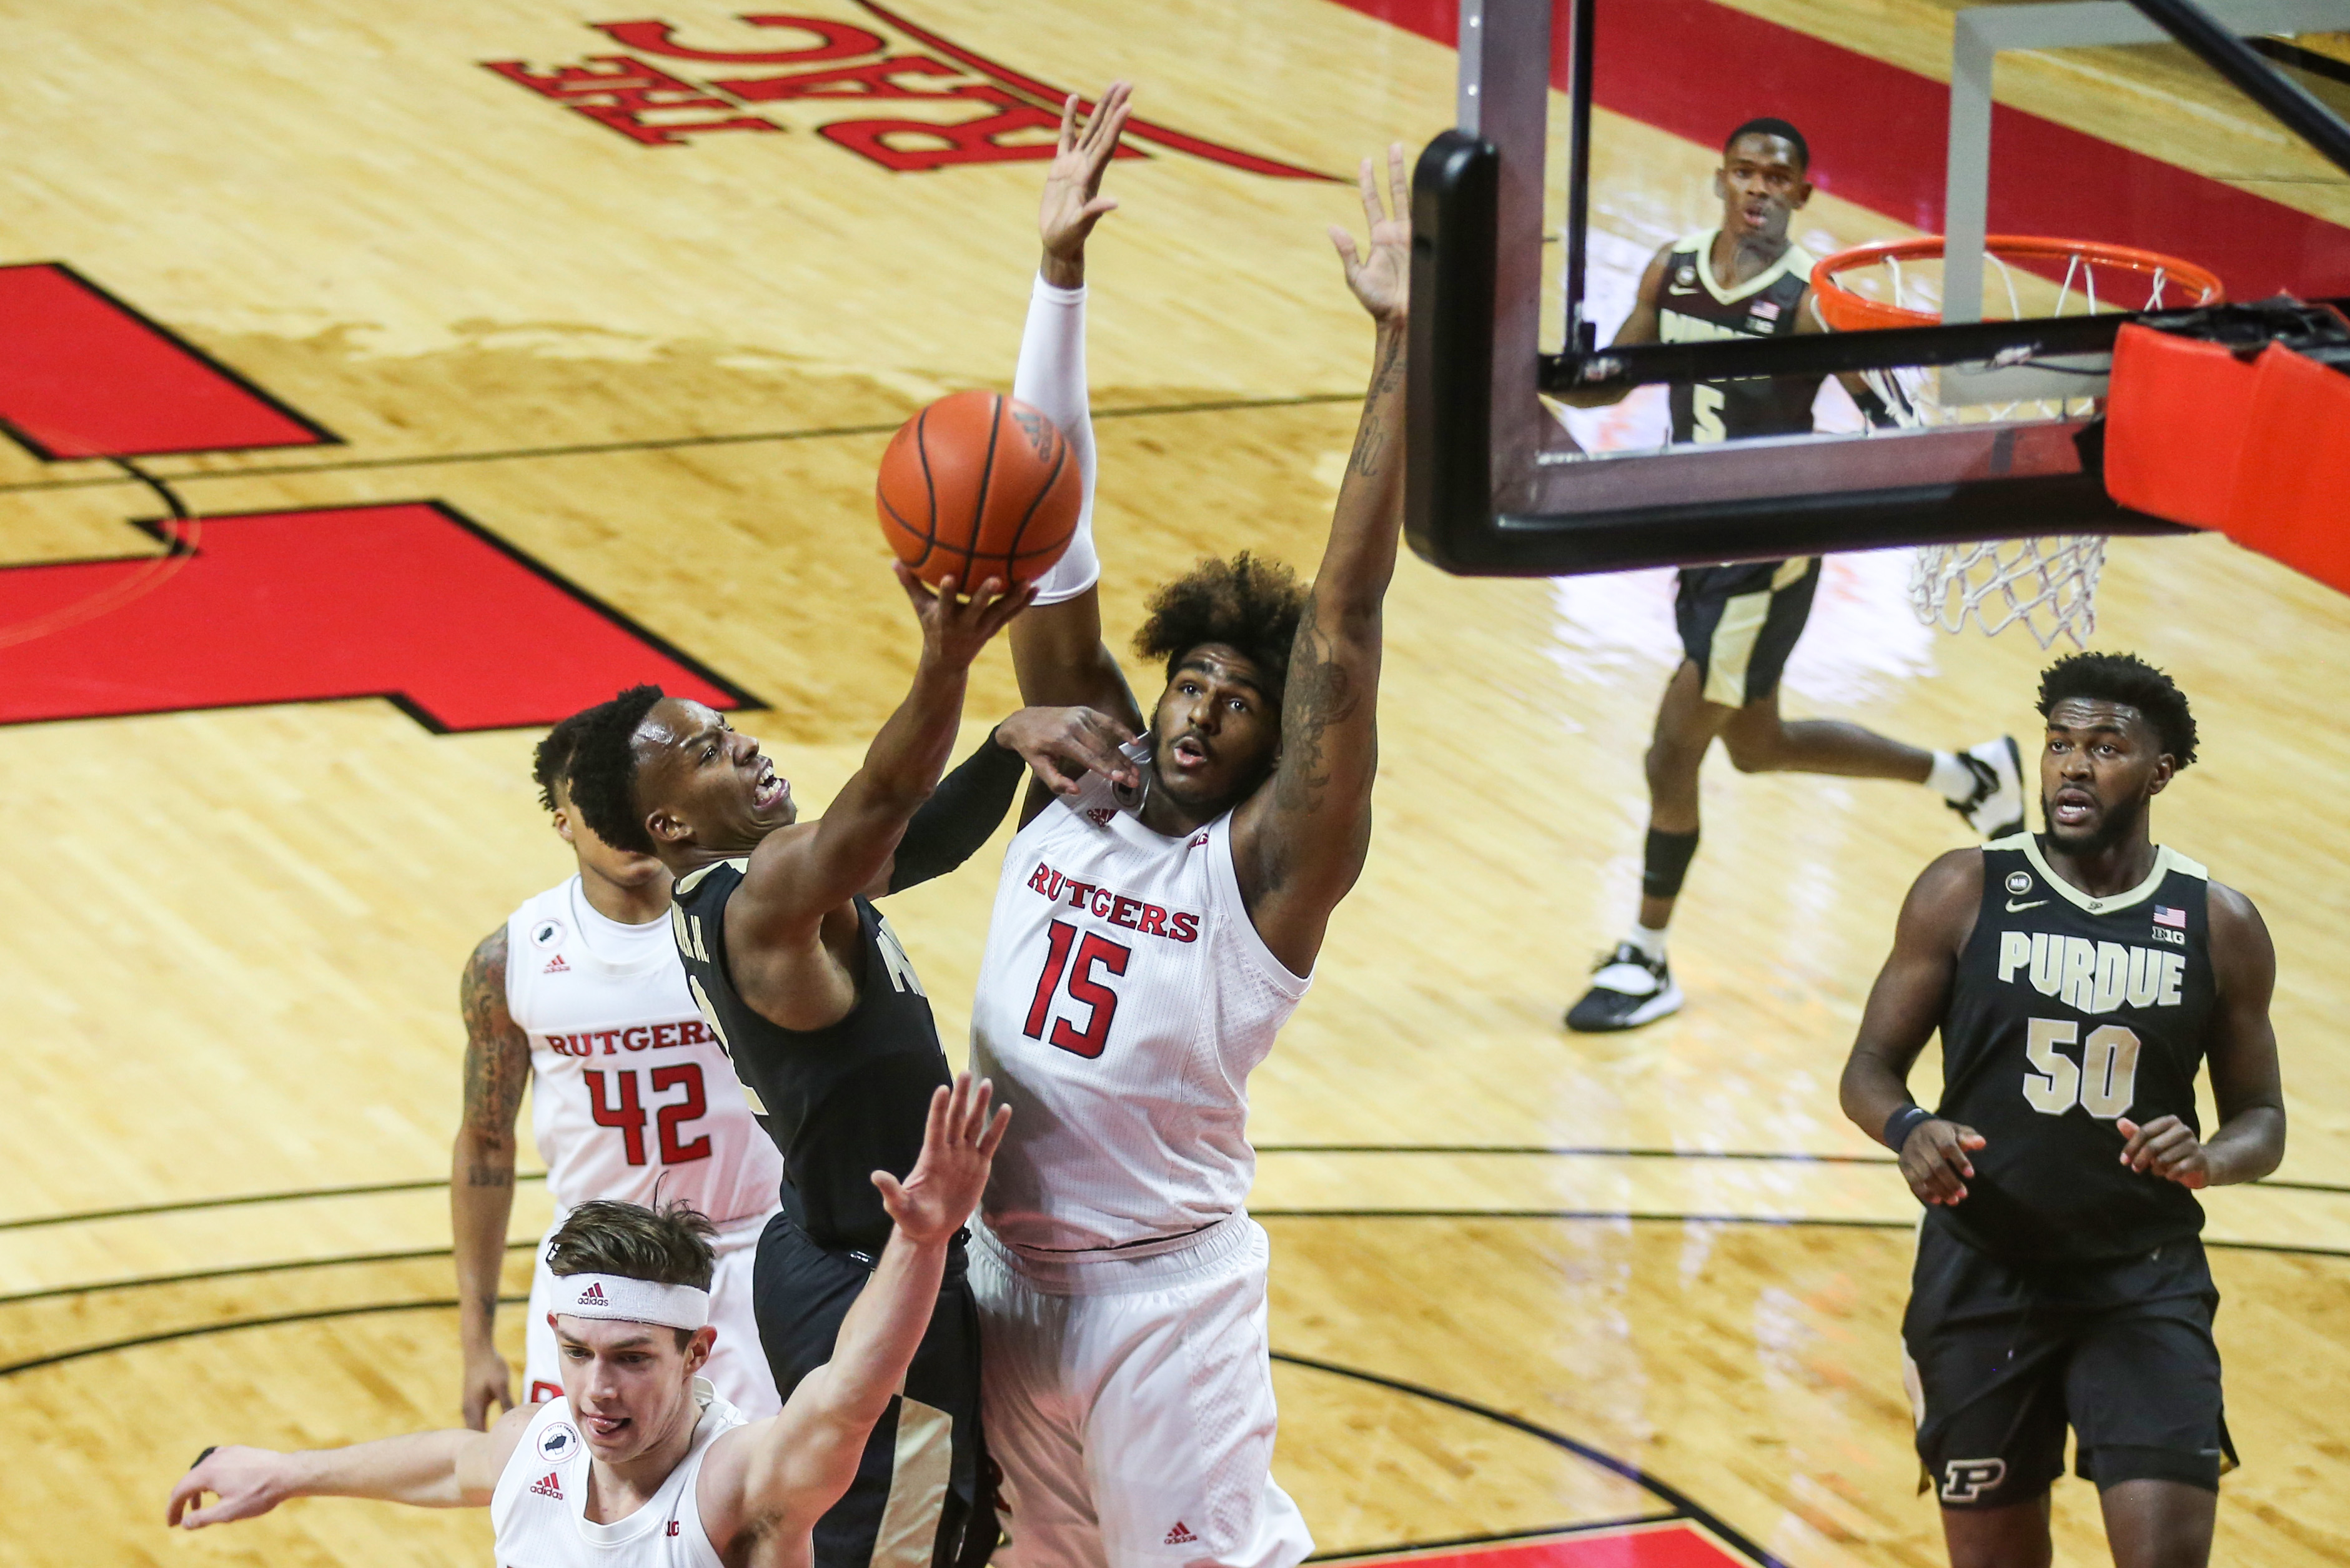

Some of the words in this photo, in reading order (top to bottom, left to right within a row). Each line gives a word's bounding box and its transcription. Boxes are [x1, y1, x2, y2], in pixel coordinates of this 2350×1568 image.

[1027, 861, 1200, 943] RUTGERS
[1023, 918, 1132, 1060] 15
[1998, 931, 2186, 1015] PURDUE
[2022, 1017, 2141, 1119] 50
[583, 1062, 712, 1166] 42
[577, 1295, 609, 1307] adidas
[530, 1486, 563, 1501] adidas
[1941, 1457, 2006, 1504] P
